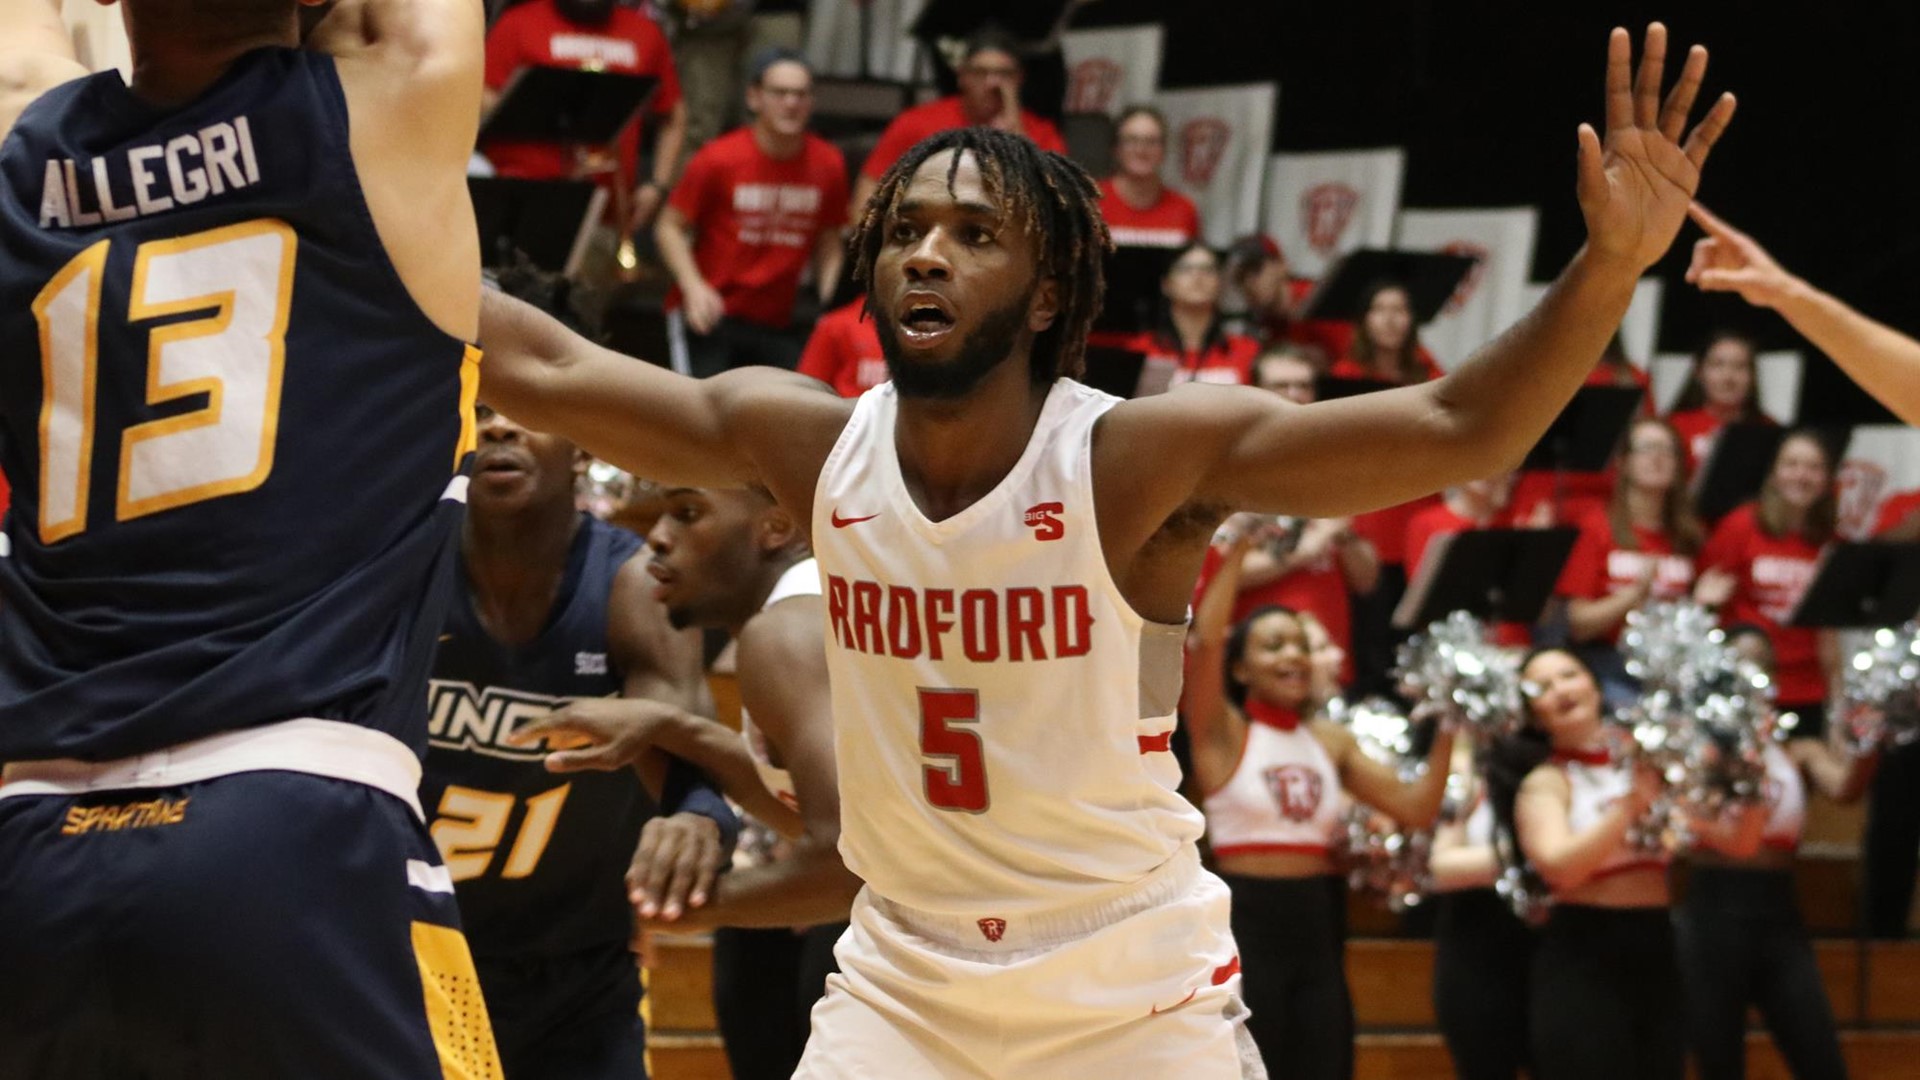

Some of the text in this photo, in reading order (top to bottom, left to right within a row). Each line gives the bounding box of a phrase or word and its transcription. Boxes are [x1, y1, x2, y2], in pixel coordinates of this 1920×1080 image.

[40, 115, 260, 229] ALLEGRI
[31, 217, 298, 546] 13
[827, 574, 1095, 663] RADFORD
[916, 686, 991, 815] 5
[430, 781, 572, 883] 21
